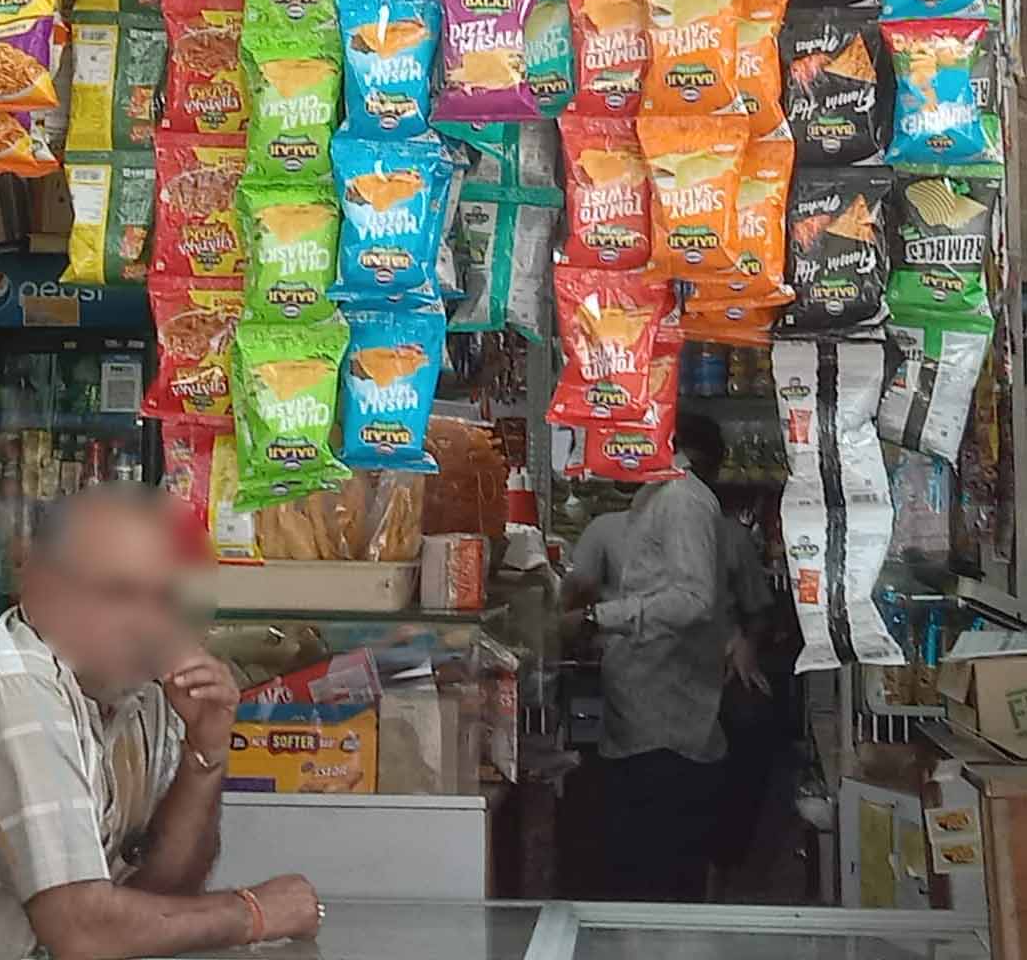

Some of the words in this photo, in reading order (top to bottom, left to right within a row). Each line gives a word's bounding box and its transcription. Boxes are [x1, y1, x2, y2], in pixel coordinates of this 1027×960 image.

[449, 19, 498, 45] DIZZY
[458, 30, 524, 53] MASALA
[667, 31, 723, 57] SIMPLY
[585, 46, 647, 70] TOMATO
[364, 61, 422, 87] MASALA
[667, 73, 717, 85] BALAJI
[531, 79, 569, 93] BALA
[269, 143, 319, 158] BALAJI
[580, 202, 643, 223] TOMATO
[671, 193, 726, 219] SIMPLY
[358, 214, 418, 240] MASALA
[669, 235, 719, 248] BALAJI
[361, 255, 411, 268] BALAJI
[923, 276, 963, 290] BALAJI
[269, 290, 318, 304] BALAJI
[359, 390, 419, 416] MASALA
[362, 430, 411, 444] BALAJI
[268, 446, 318, 460] BALAJI
[606, 442, 655, 455] BALAJI
[272, 734, 316, 749] SOFTER
